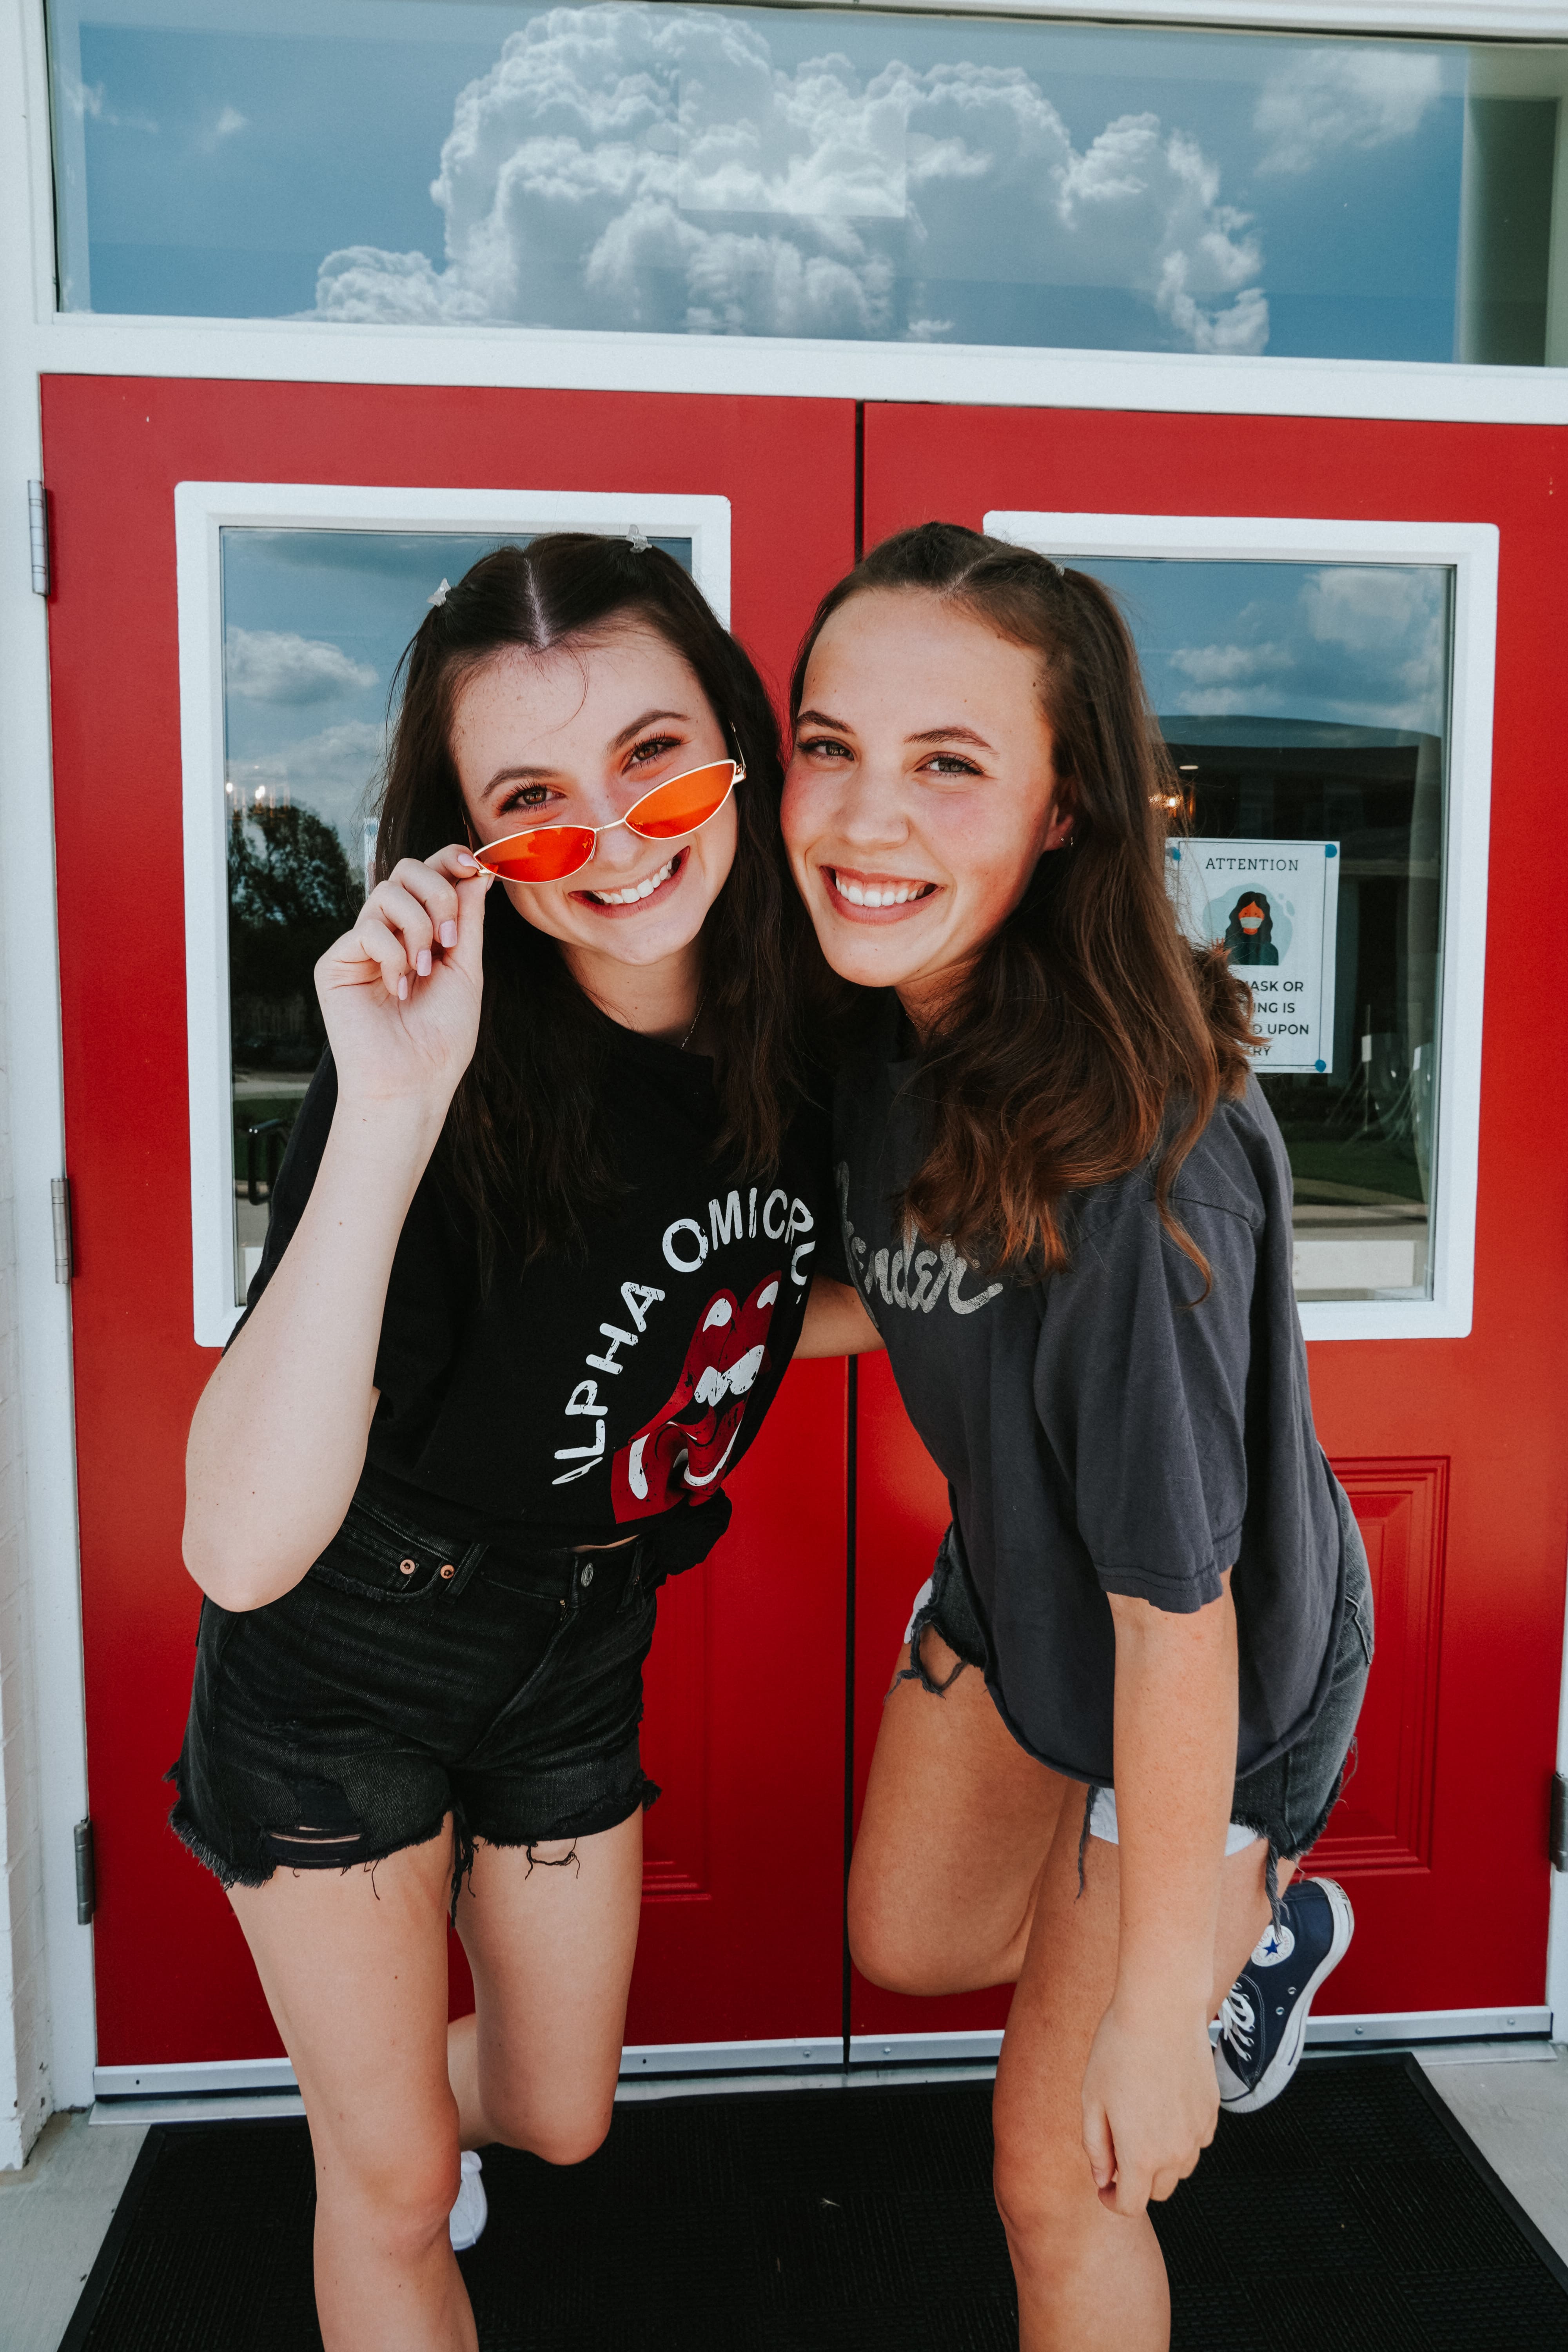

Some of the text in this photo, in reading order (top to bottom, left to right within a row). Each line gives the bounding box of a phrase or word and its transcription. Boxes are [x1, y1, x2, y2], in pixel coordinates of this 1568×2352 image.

[1205, 858, 1298, 871] ATTENTION
[1246, 981, 1303, 992] ASK OR
[1283, 1003, 1295, 1013] IS
[1268, 1024, 1308, 1034] UPON
[552, 1281, 666, 1485] ALPHA
